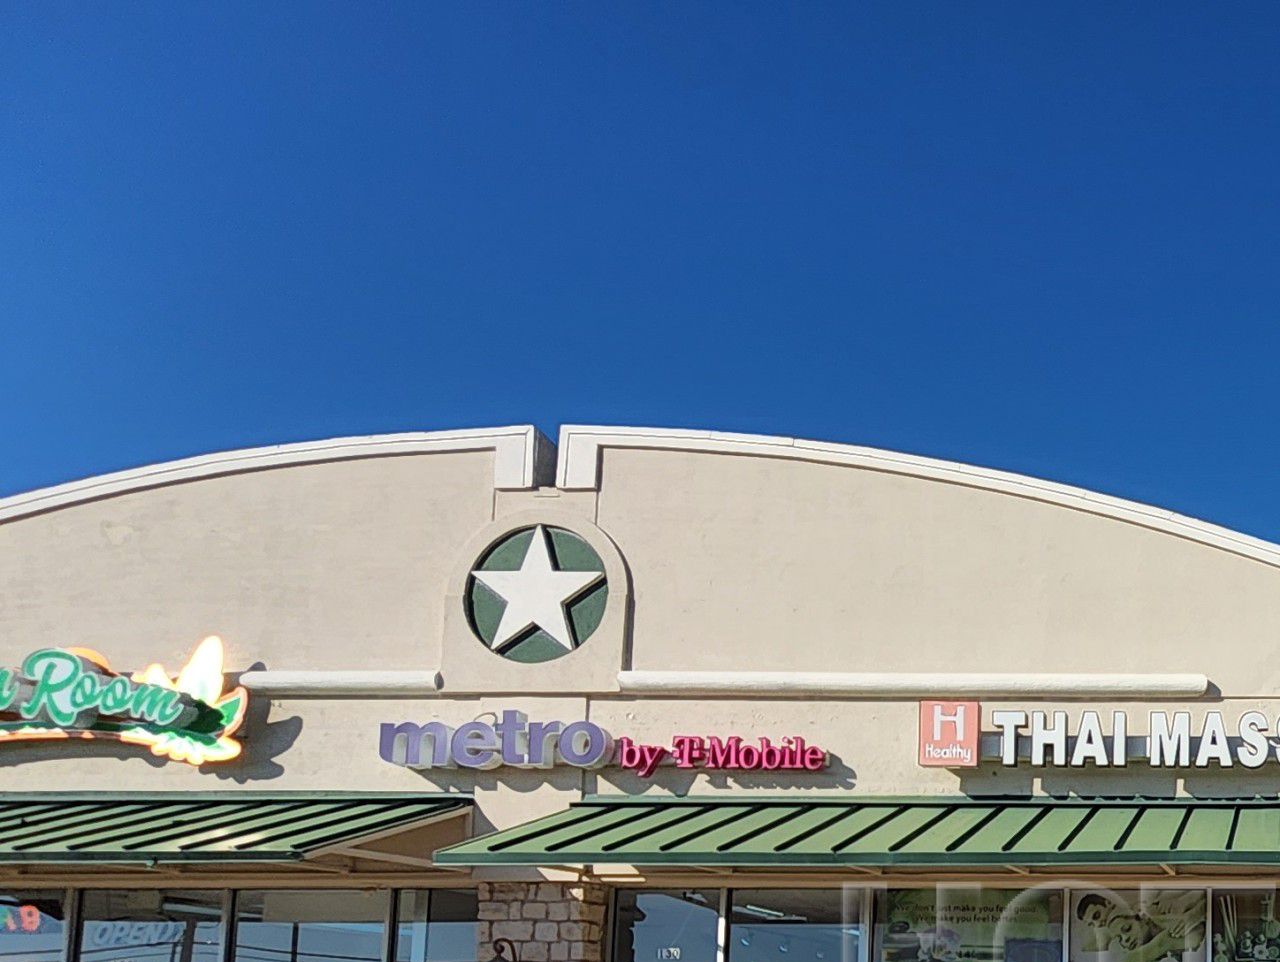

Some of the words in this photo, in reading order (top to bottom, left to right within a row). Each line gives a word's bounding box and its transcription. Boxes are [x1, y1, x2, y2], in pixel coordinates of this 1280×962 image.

[20, 648, 185, 727] Room
[379, 710, 607, 767] metro
[620, 737, 665, 778] by
[672, 735, 827, 770] T-Mobile
[925, 743, 971, 763] Healthy
[993, 711, 1127, 767] THAI
